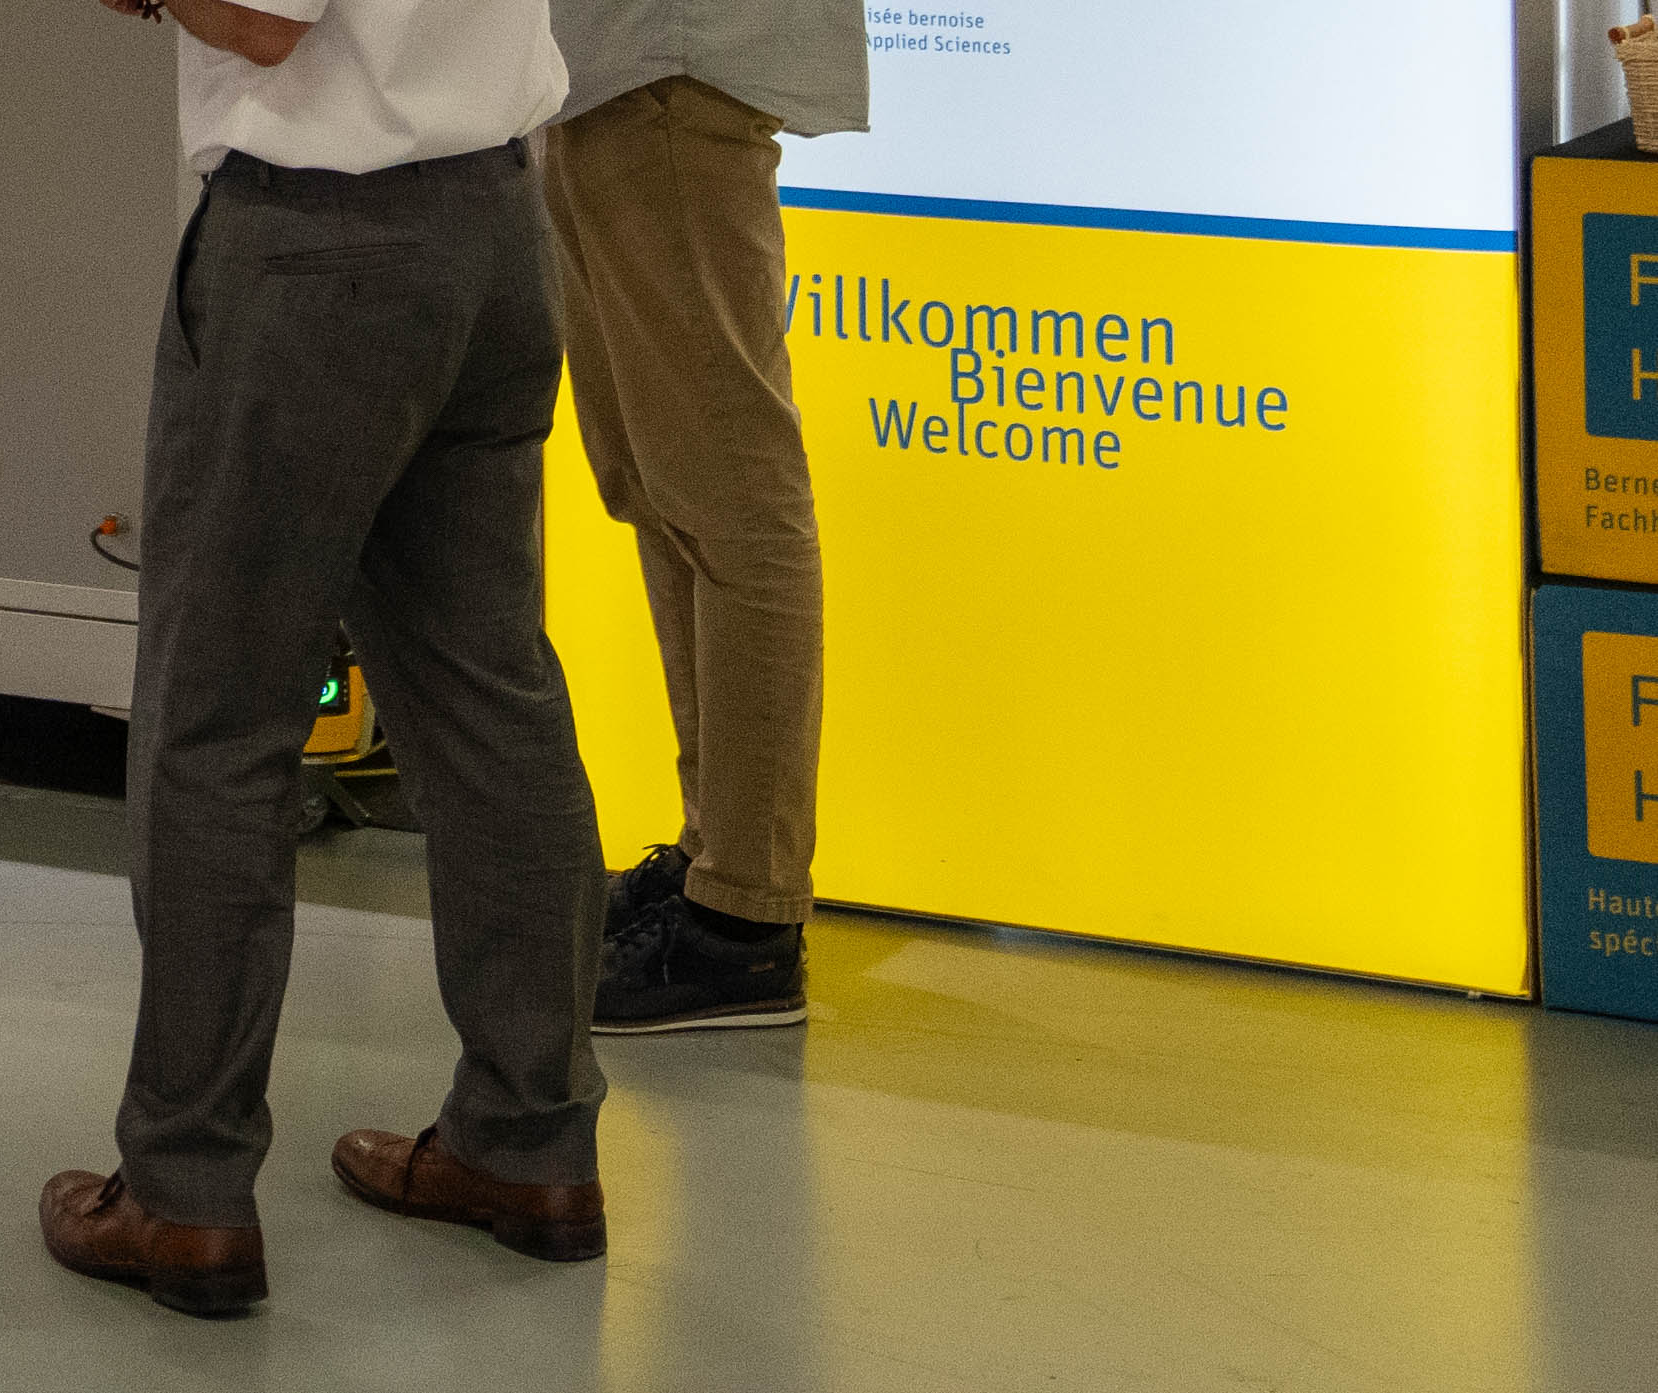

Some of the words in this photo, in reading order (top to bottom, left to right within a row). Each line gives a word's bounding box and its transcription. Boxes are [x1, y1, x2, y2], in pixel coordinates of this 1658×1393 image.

[908, 9, 985, 29] bernoise
[934, 35, 1012, 55] Sciences
[949, 347, 1288, 431] Bienvenue
[868, 397, 1123, 470] Welcome
